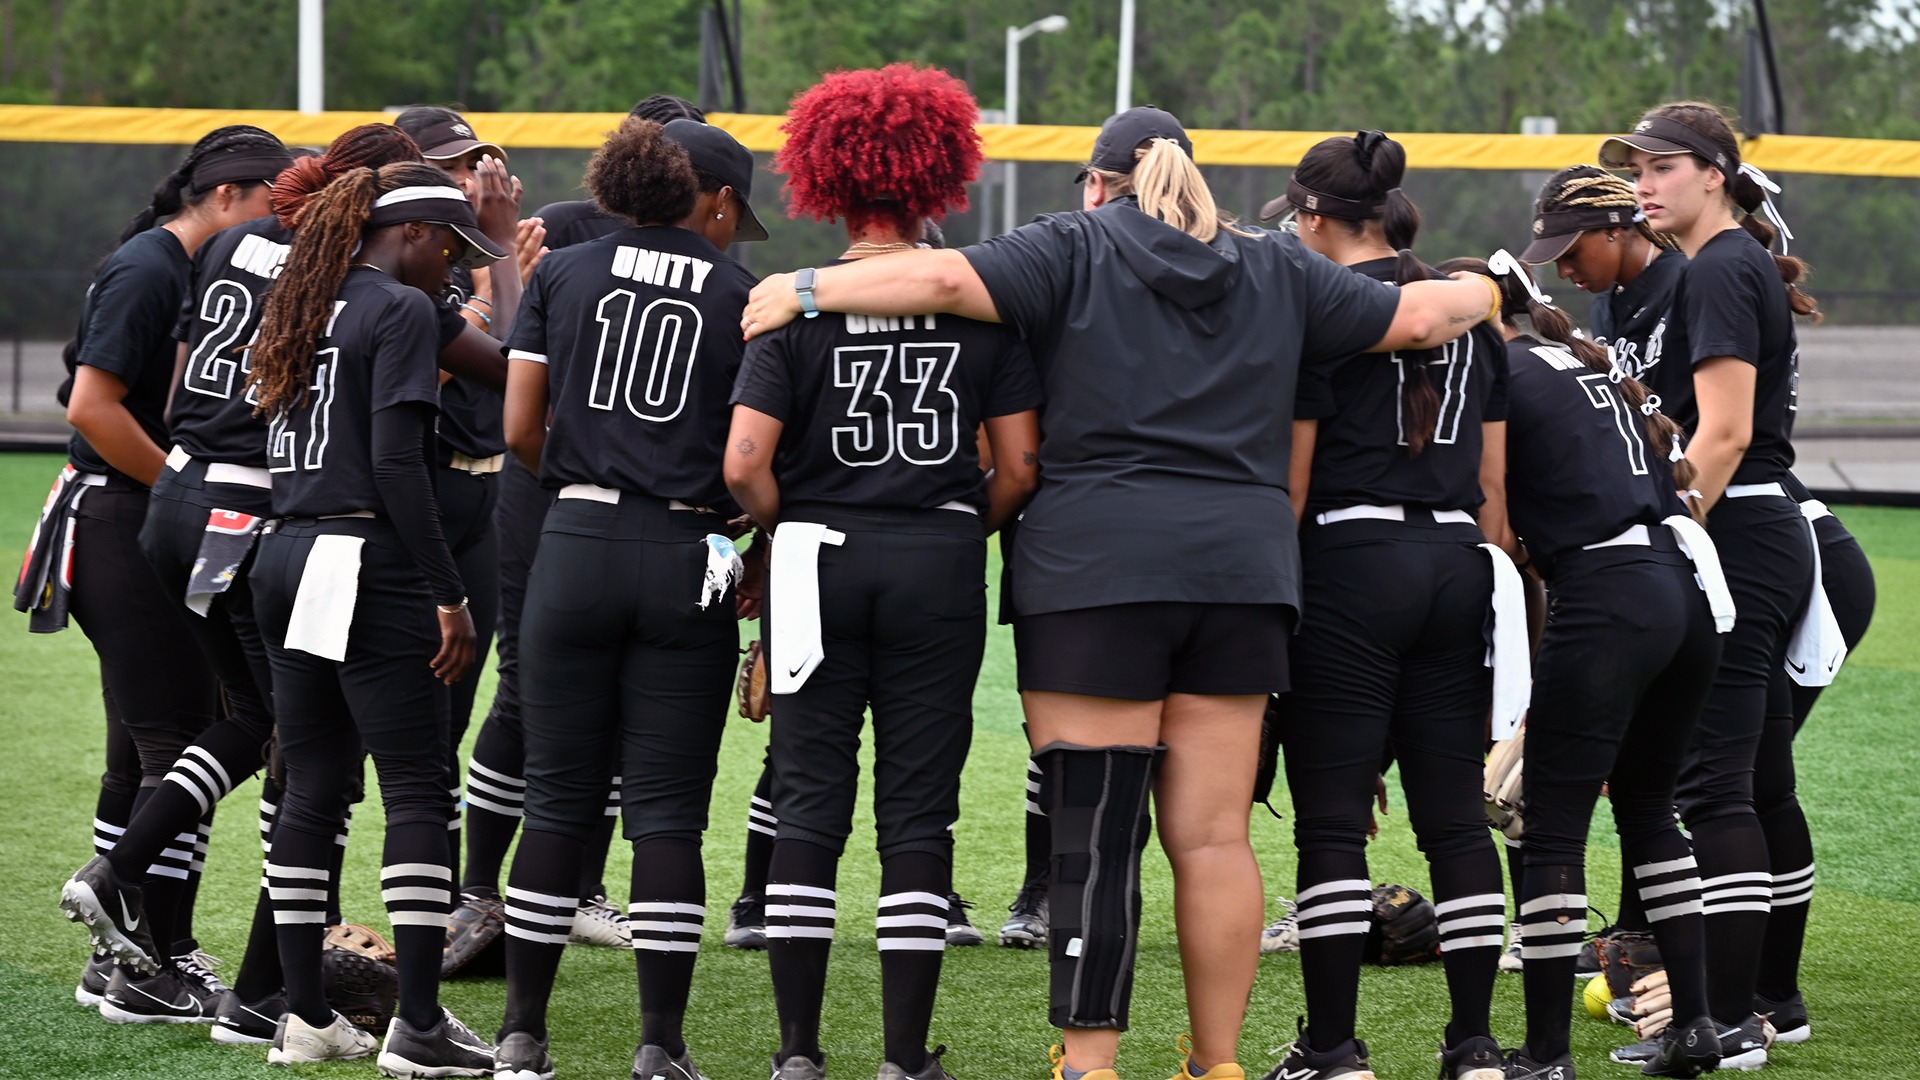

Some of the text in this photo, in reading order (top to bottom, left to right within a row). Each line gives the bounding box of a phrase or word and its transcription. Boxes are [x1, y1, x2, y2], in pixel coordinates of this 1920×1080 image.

[611, 245, 714, 294] UNITY
[184, 279, 268, 406] 2
[588, 288, 703, 422] 10
[832, 342, 960, 467] 33
[1575, 373, 1649, 476] 7
